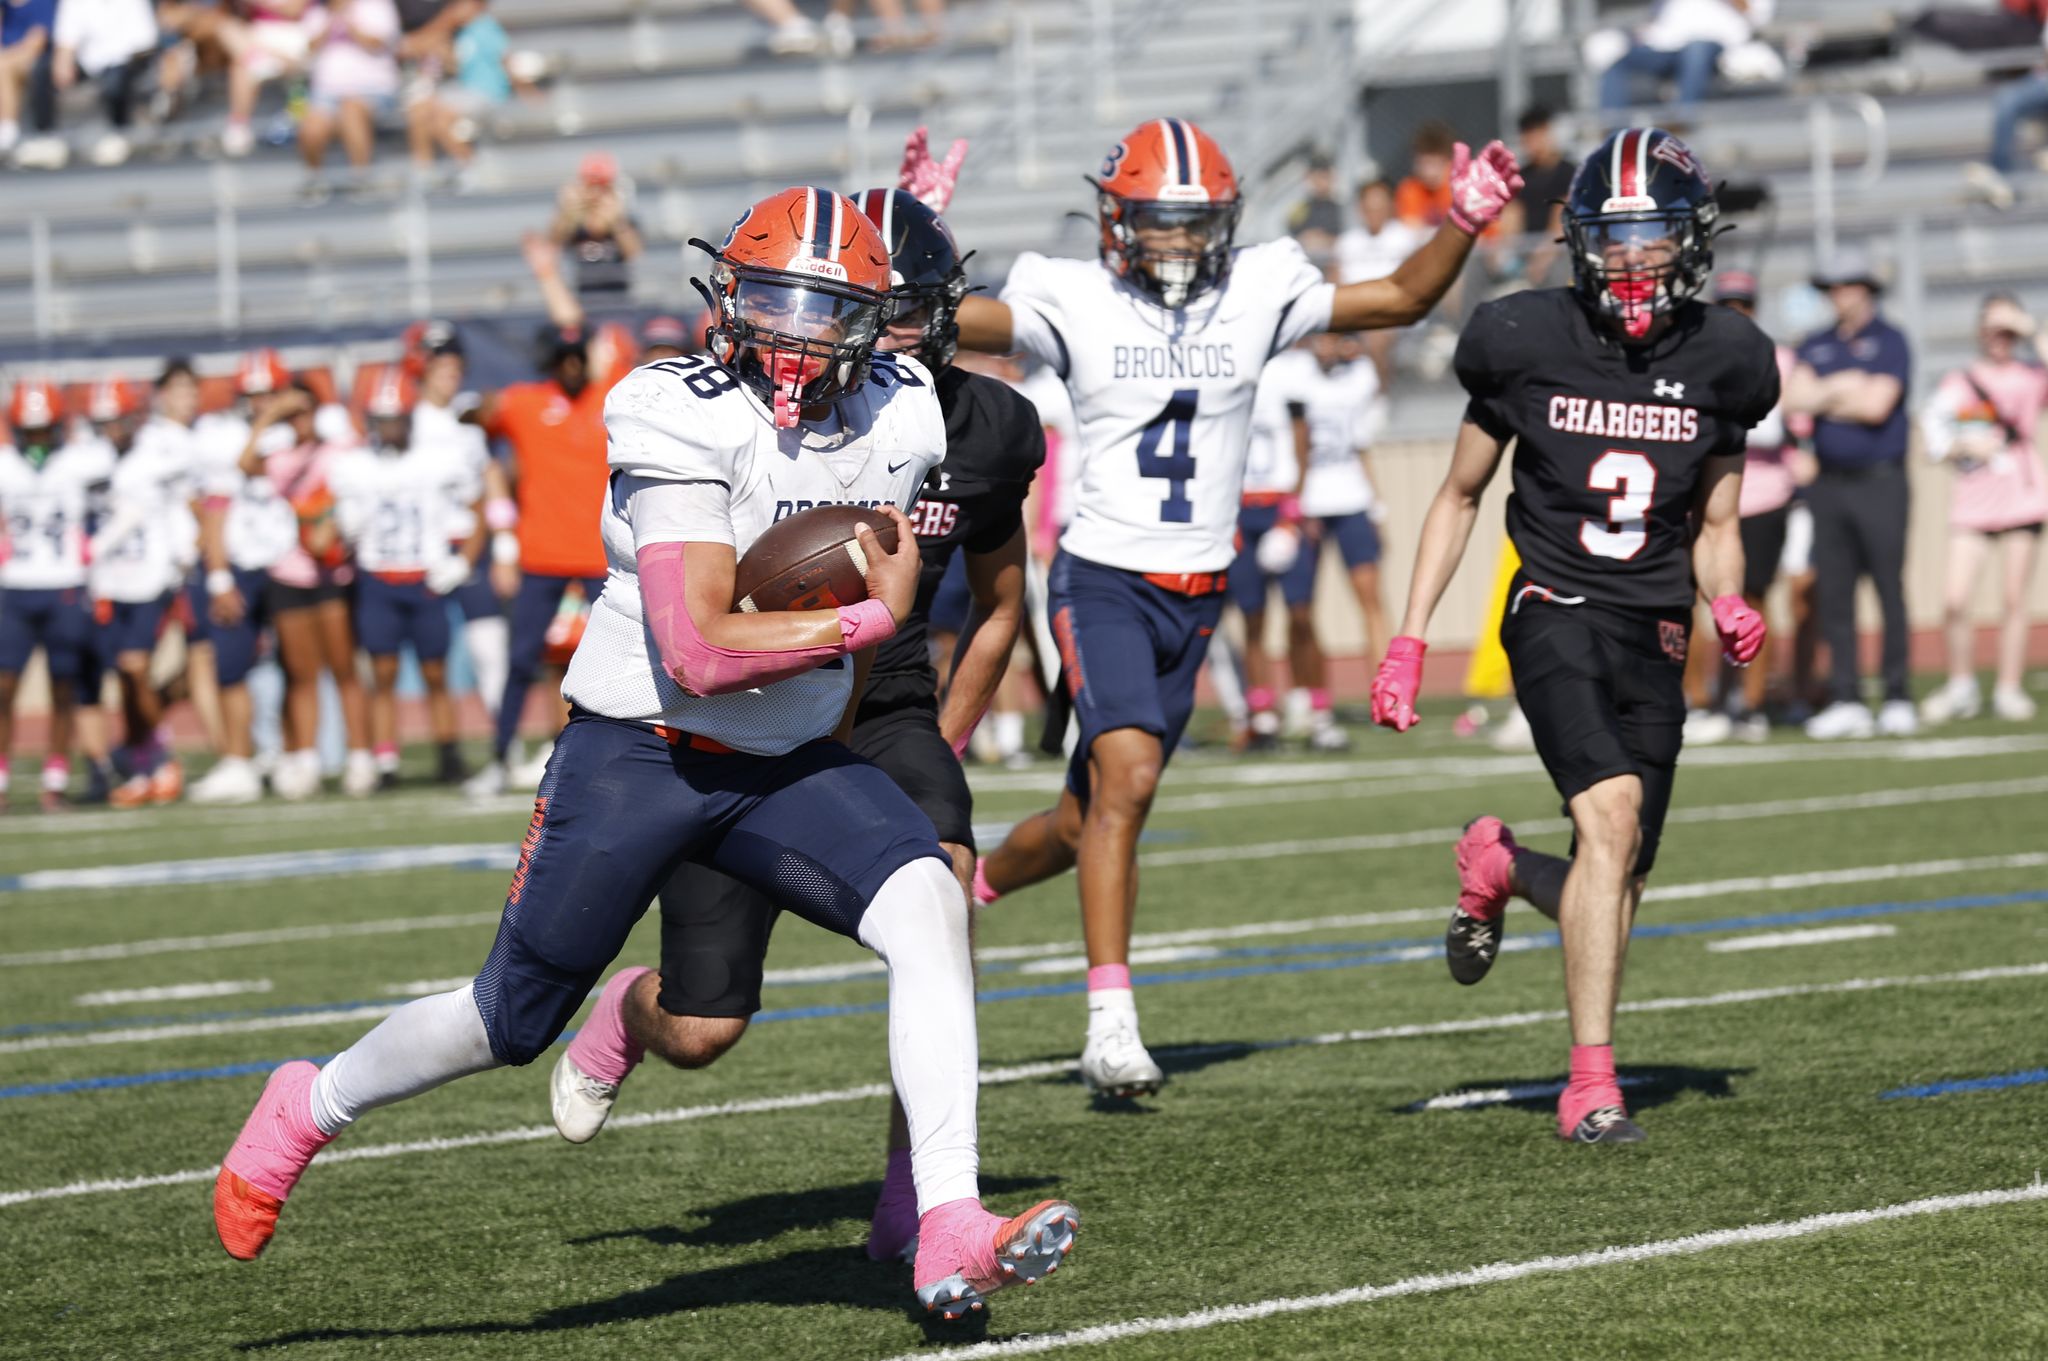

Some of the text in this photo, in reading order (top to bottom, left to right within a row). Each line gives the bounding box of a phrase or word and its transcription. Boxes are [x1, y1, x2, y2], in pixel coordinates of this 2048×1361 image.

[644, 354, 740, 400] 28
[1113, 342, 1236, 379] BRONCOS
[1548, 394, 1699, 442] CHARGERS
[1135, 388, 1200, 524] 4
[908, 499, 961, 537] ERS
[1578, 448, 1659, 562] 3
